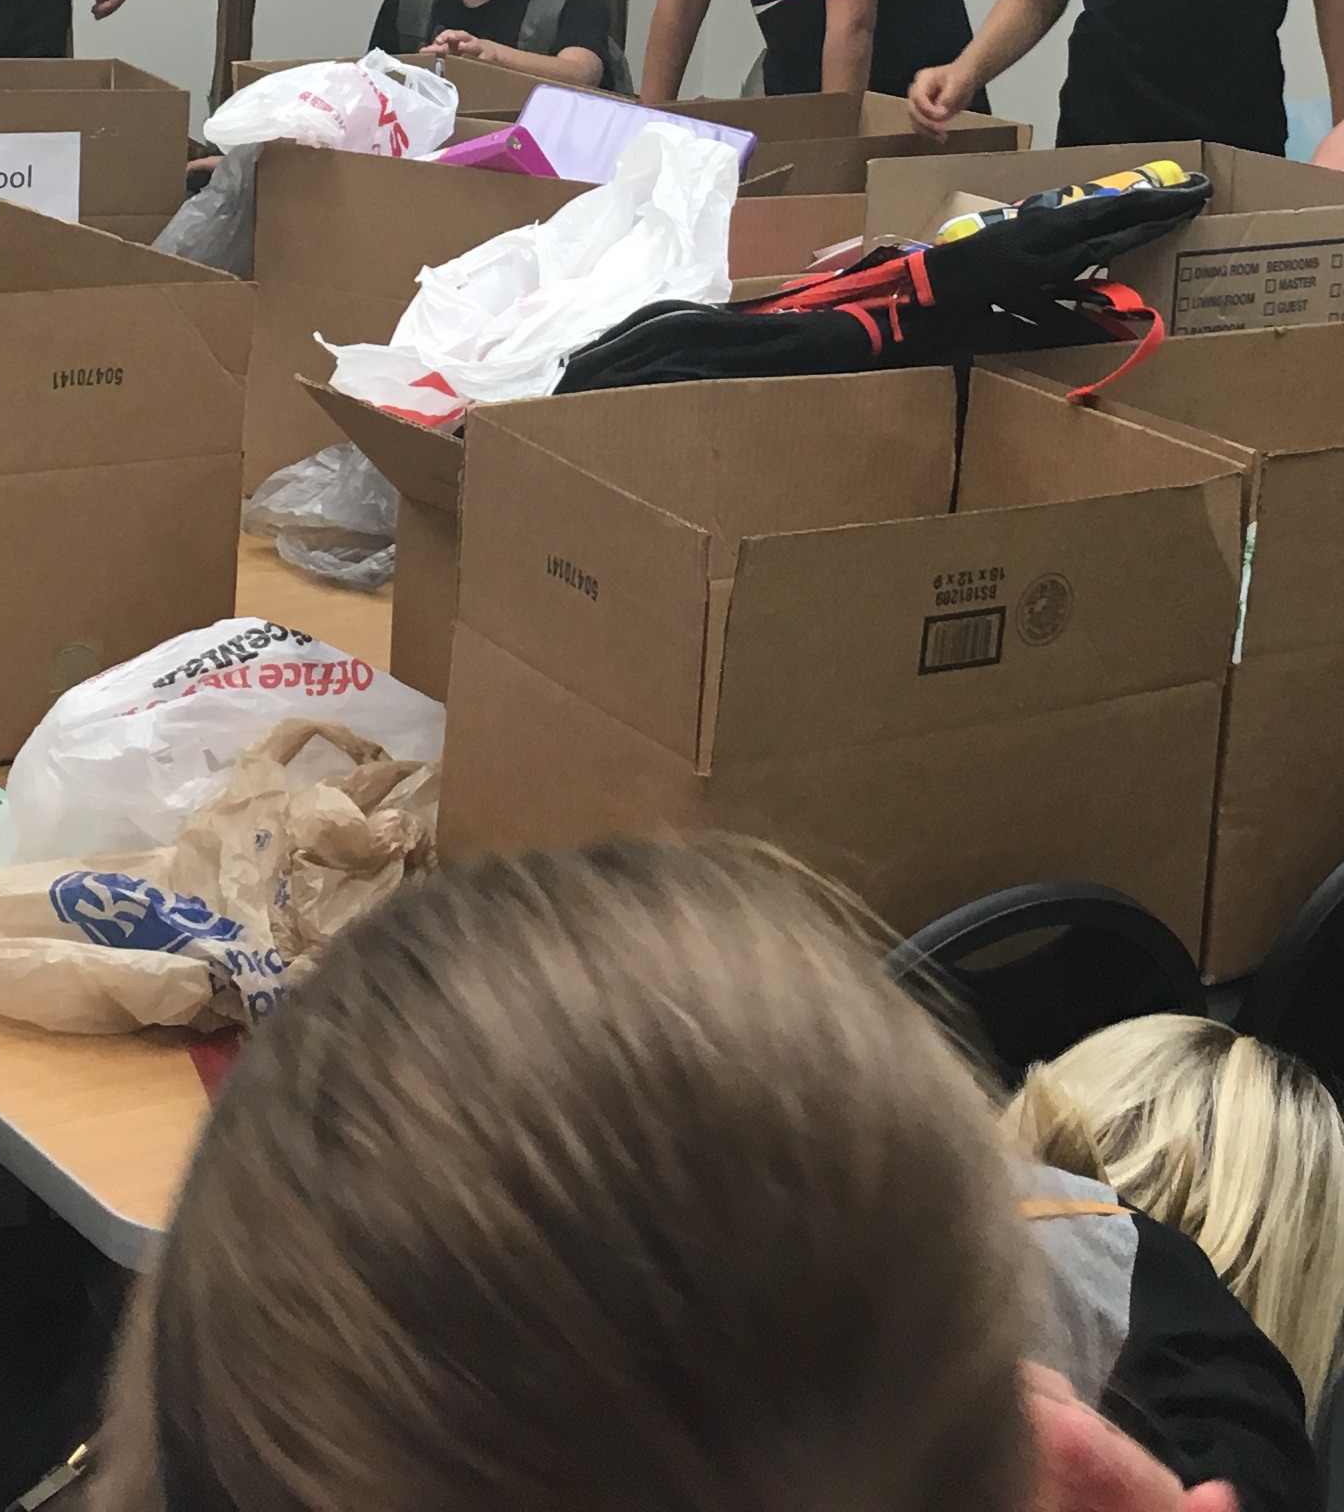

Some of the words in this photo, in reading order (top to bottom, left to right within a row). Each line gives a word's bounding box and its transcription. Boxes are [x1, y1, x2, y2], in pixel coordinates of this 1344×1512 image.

[1193, 264, 1228, 279] DINING
[1229, 262, 1260, 278] ROOM
[1265, 256, 1320, 273] BEDROOMS
[1277, 276, 1317, 290] MASTER
[1225, 292, 1256, 307] ROOM
[1275, 299, 1308, 314] GUEST
[51, 366, 125, 391] 50470141
[258, 658, 374, 697] Office
